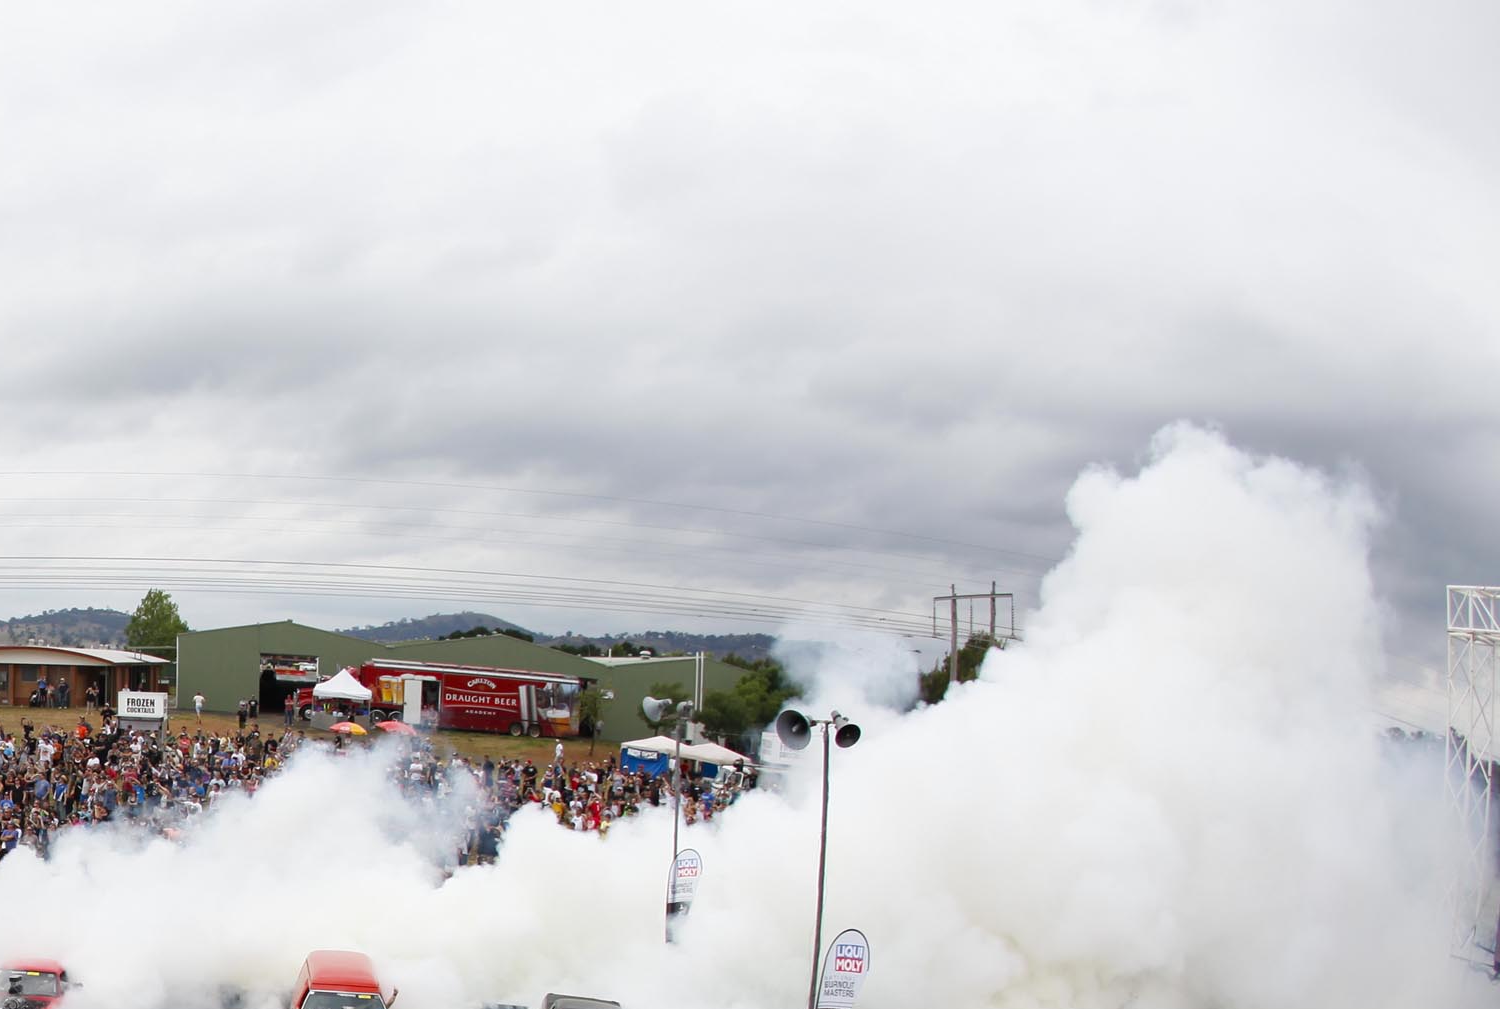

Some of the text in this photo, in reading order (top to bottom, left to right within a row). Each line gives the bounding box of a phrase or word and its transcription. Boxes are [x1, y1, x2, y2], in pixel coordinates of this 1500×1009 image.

[467, 678, 497, 689] CARLTON
[126, 698, 155, 707] FROZEN
[445, 693, 517, 707] DRAUGHT BEER
[677, 860, 698, 868] LIQUI
[677, 868, 698, 877] MOLY
[837, 945, 864, 958] LIQUI
[835, 959, 863, 972] MOLY
[824, 981, 856, 989] BURNOUT
[823, 989, 855, 998] MASTERS
